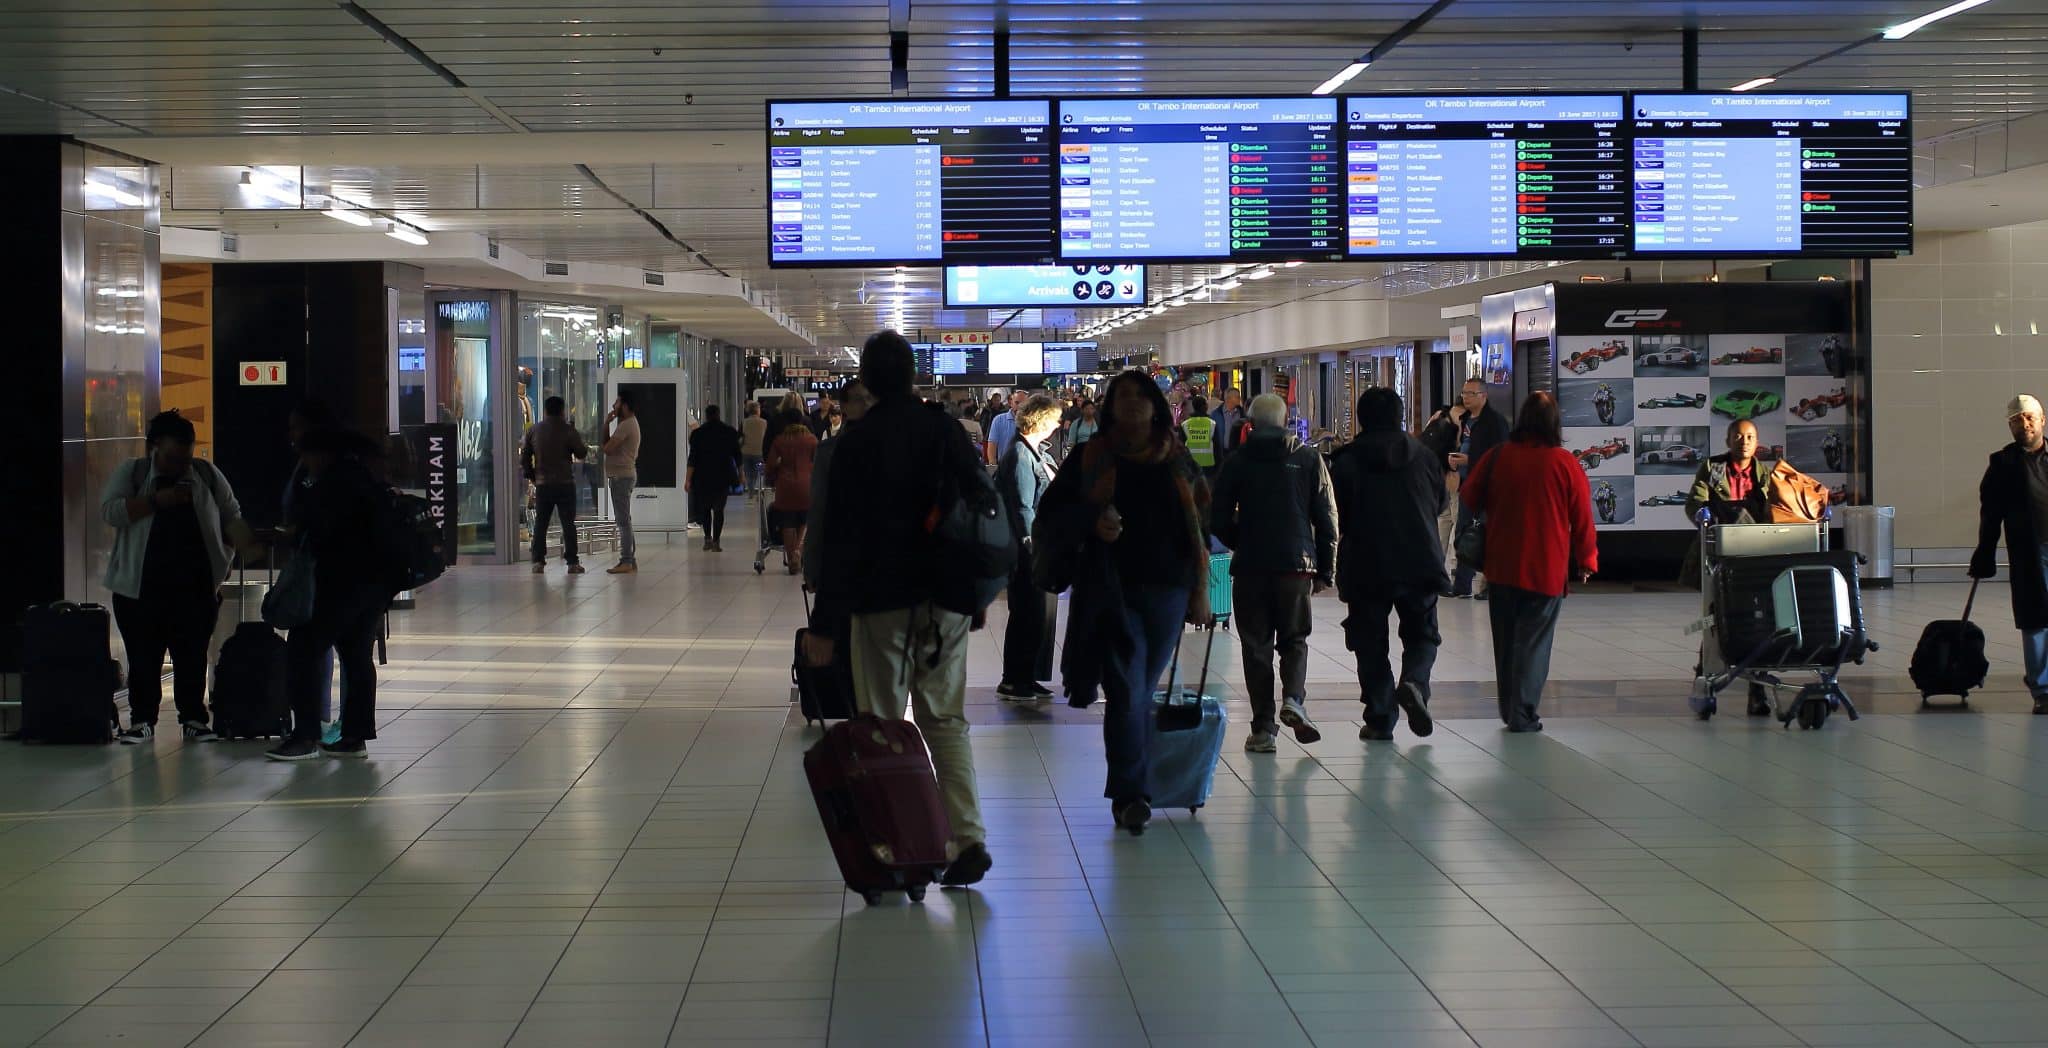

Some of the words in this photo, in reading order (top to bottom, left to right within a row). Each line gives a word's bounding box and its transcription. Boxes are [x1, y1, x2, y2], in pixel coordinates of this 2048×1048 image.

[1233, 102, 1259, 110] Airport
[1519, 99, 1545, 107] Airport
[1805, 98, 1831, 106] Airport
[893, 105, 942, 113] International
[944, 104, 971, 113] Airport
[802, 129, 821, 137] Flight#
[1528, 217, 1554, 225] Departing
[1027, 285, 1070, 297] Arrivals
